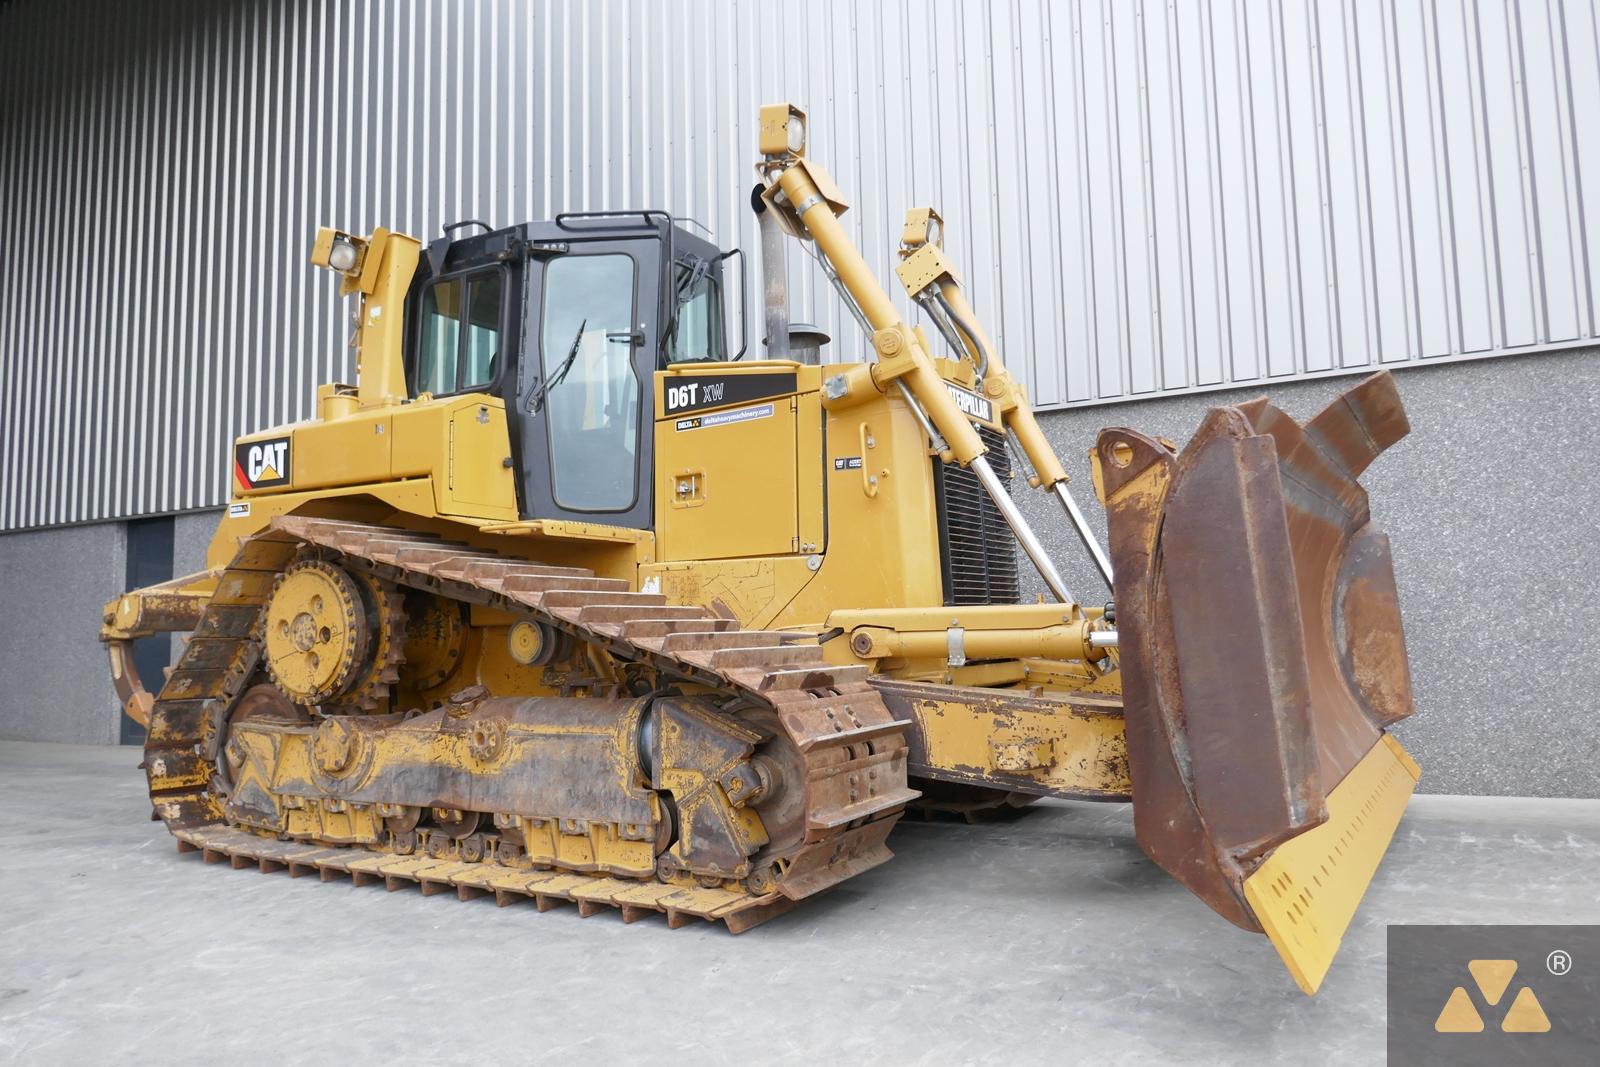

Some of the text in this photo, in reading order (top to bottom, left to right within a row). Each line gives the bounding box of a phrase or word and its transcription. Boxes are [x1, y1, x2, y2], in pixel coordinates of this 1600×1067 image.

[668, 382, 724, 410] D6T XW
[248, 442, 287, 482] CAT
